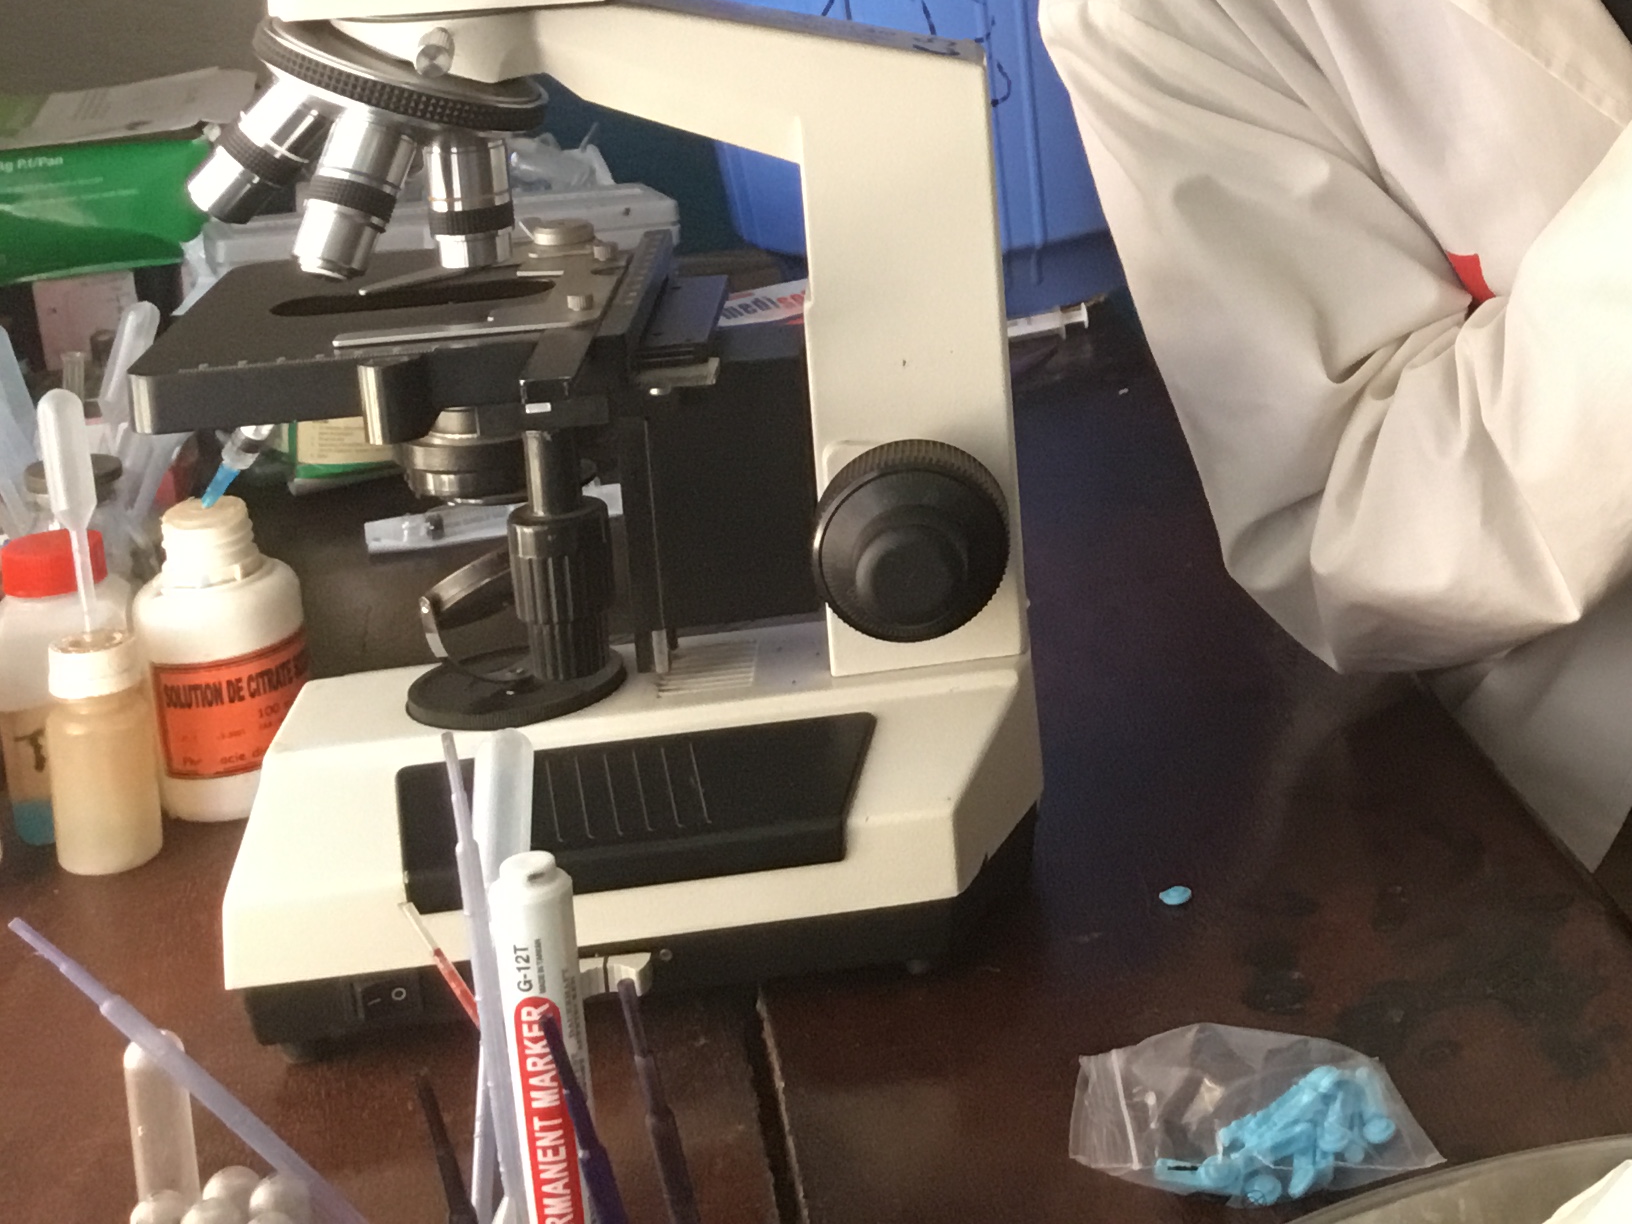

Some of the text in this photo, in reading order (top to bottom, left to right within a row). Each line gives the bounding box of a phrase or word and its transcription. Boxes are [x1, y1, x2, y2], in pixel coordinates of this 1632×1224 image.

[164, 679, 224, 709] SOLUTION
[226, 677, 245, 703] DE
[247, 659, 293, 698] CITRATE
[258, 703, 280, 719] 100
[513, 944, 533, 992] G-12T
[538, 974, 546, 994] MADE
[520, 1002, 560, 1108] MARKER
